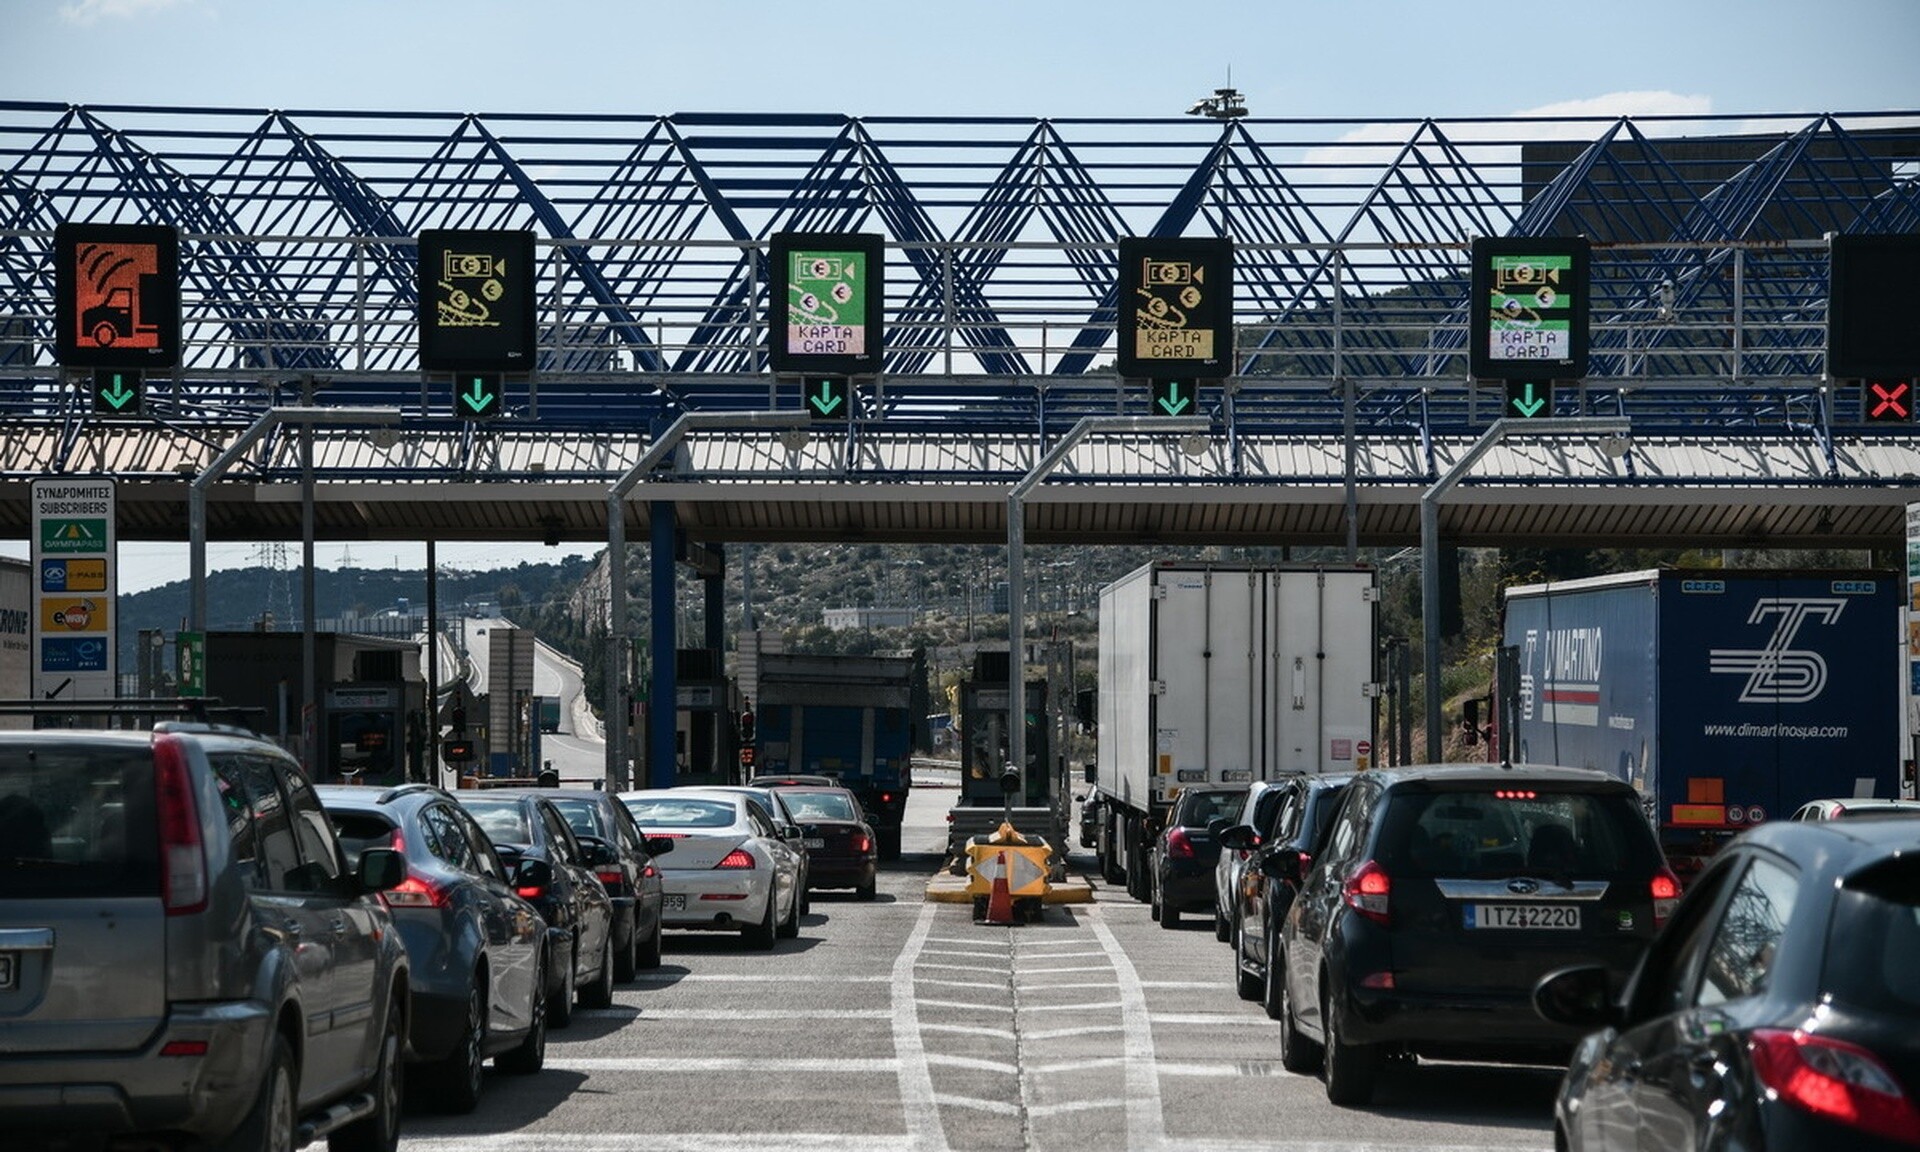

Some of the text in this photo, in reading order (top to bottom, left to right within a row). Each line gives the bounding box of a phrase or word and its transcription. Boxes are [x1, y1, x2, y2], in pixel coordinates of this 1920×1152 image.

[798, 326, 853, 338] ΚΑΡΤΑ
[1146, 331, 1202, 343] ΚΑΡΤΑ
[1500, 331, 1557, 343] ΚΑΡΤΑ
[803, 340, 847, 352] CARD
[1151, 345, 1195, 357] CARD
[1505, 345, 1550, 358] CARD
[36, 487, 111, 499] ΣΥΝΔΡΟΜΗΤΕΣ
[40, 502, 108, 514] SUBSCRIBERS
[1555, 627, 1602, 682] MARTINO
[1704, 722, 1848, 740] www.dimartinospa.com
